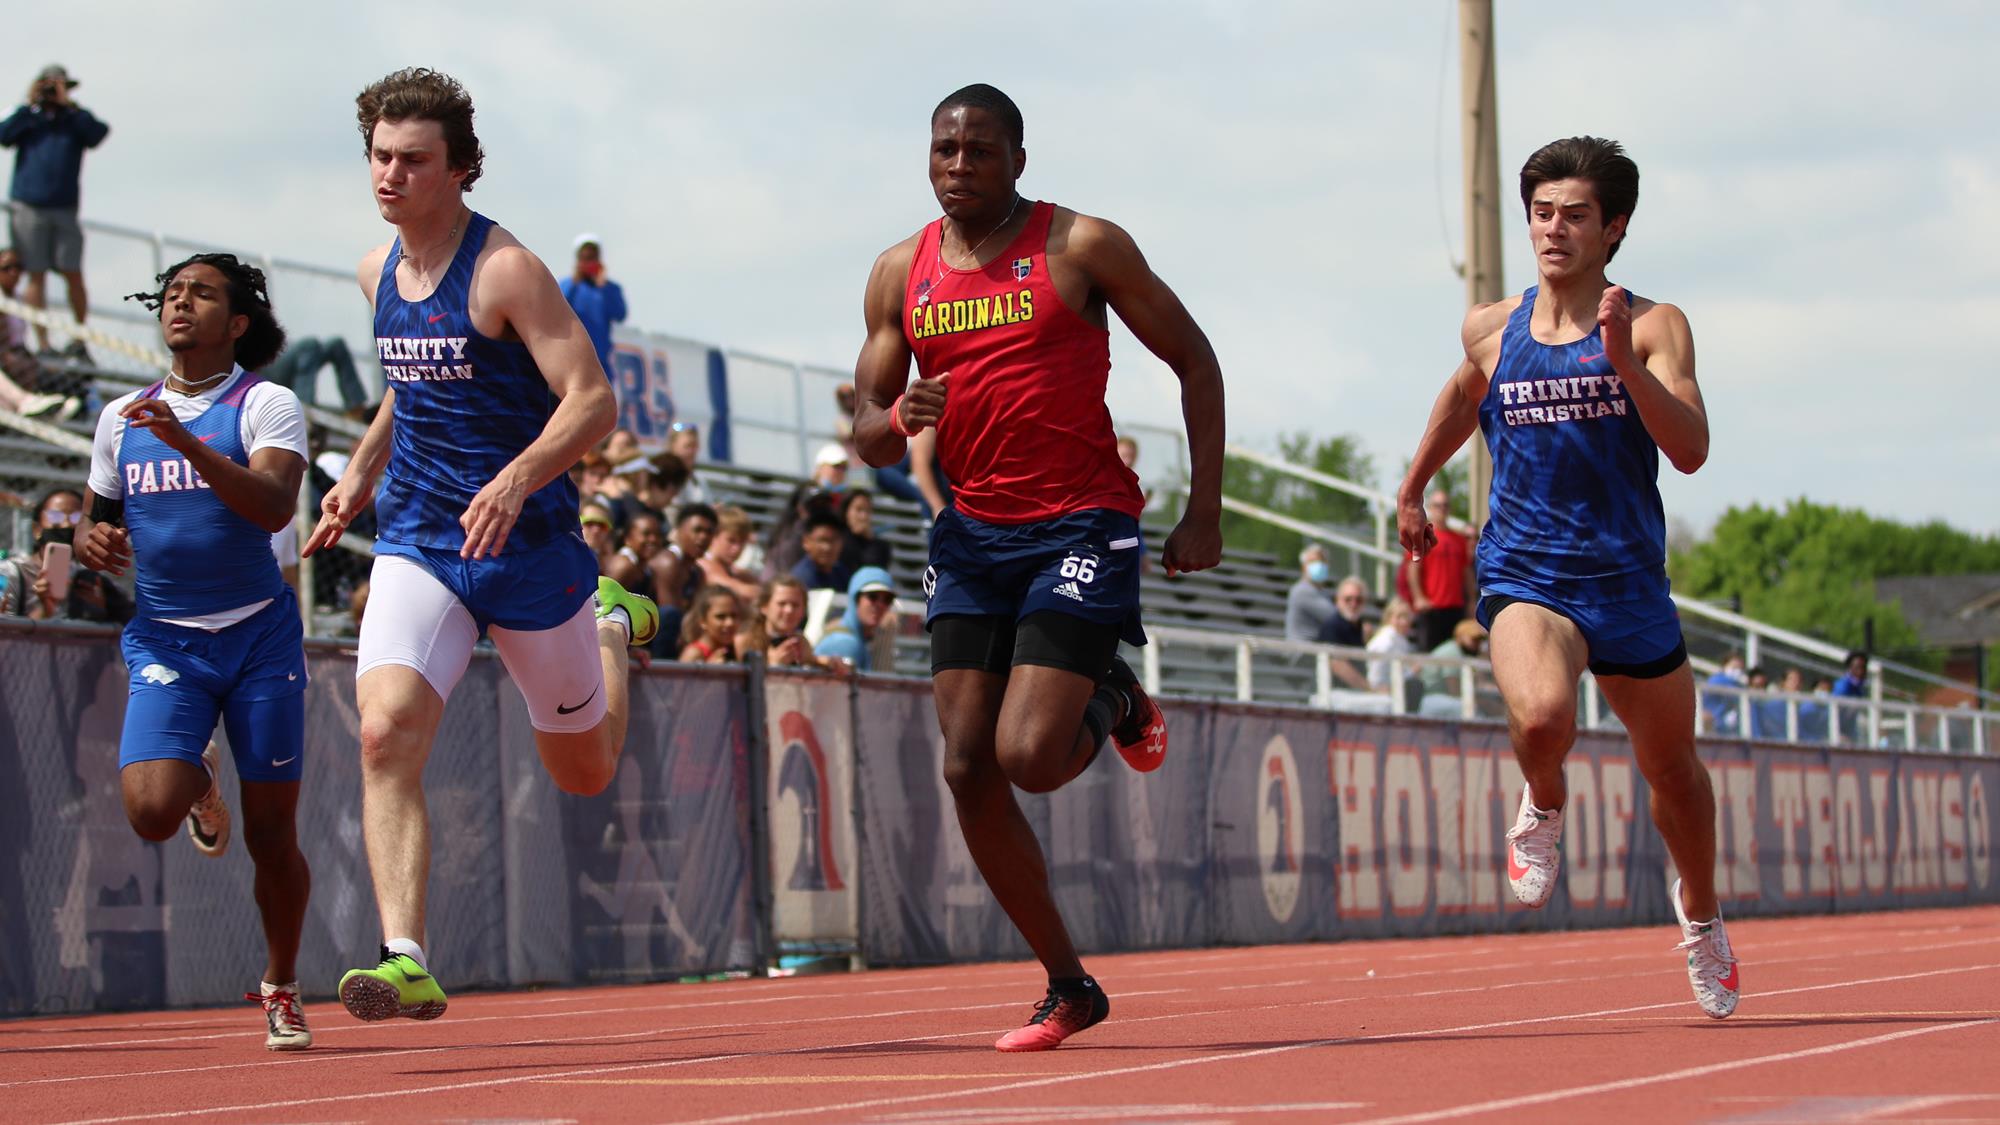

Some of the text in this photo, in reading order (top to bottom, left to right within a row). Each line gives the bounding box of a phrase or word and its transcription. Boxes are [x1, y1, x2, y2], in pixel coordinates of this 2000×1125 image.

[911, 289, 1034, 340] CARDINALS
[1499, 375, 1623, 405] TRINITY
[1504, 400, 1627, 426] CHRISTIAN
[1060, 556, 1098, 584] 66
[1052, 587, 1084, 602] adidas
[1560, 752, 1635, 909] OF
[1770, 762, 1969, 897] TROJANS
